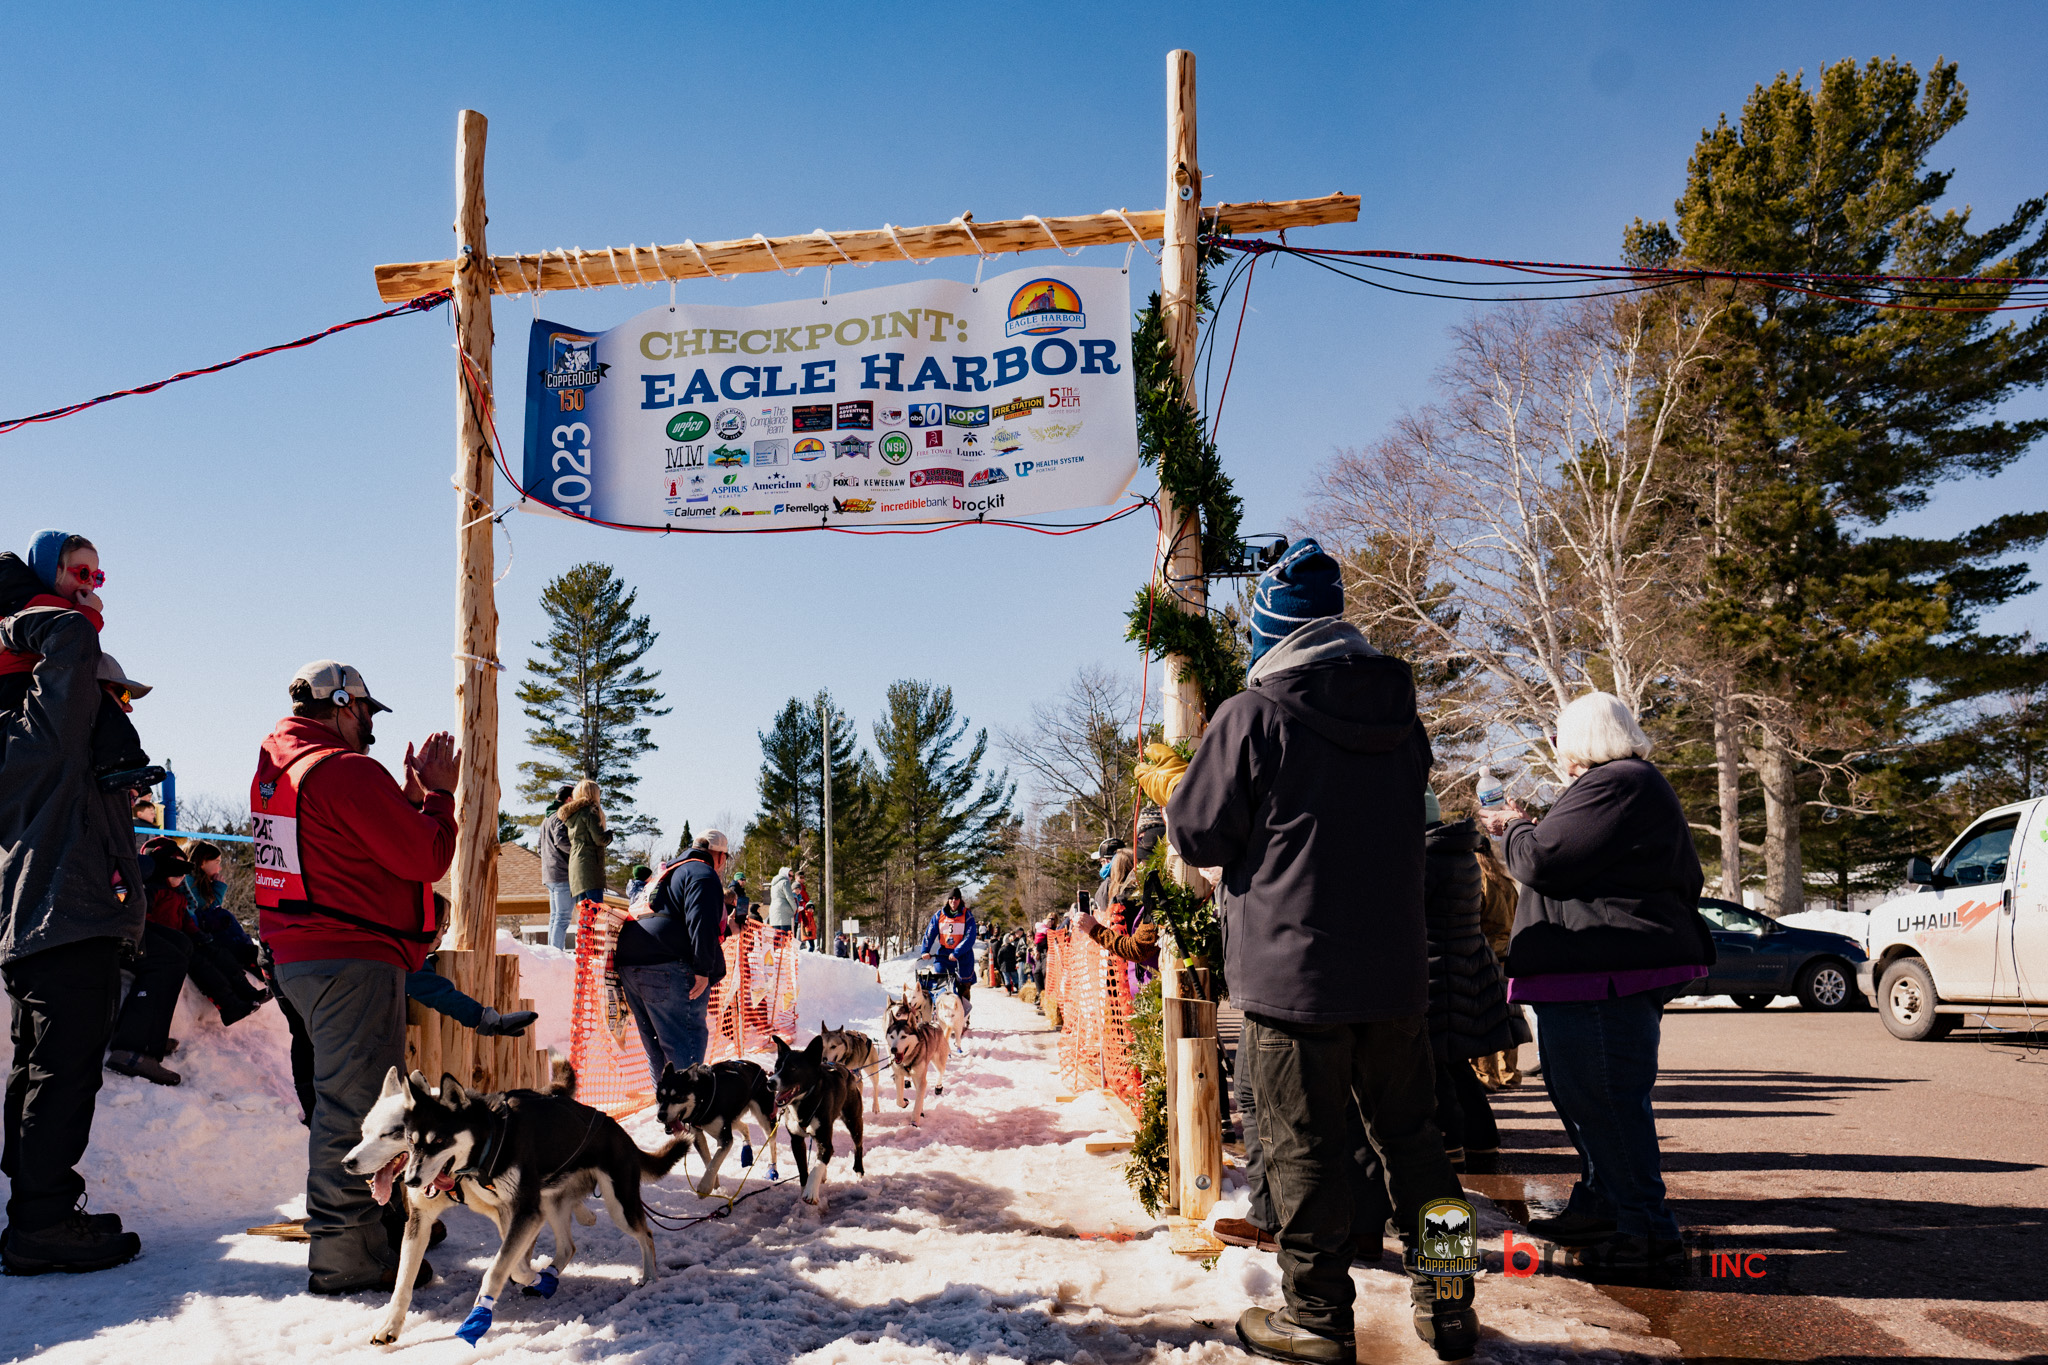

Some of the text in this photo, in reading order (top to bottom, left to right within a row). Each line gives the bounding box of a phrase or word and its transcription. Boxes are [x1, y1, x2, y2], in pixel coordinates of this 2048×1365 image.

[1009, 315, 1038, 330] EAGLE
[1041, 314, 1082, 322] HARBOR
[639, 307, 968, 361] CHECKPOINT:
[641, 338, 1121, 410] EAGLE HARBOR
[558, 388, 585, 412] 150
[1061, 398, 1080, 407] ELM
[773, 406, 786, 416] The
[994, 405, 1010, 417] FIRE
[1011, 399, 1042, 411] STATION
[919, 404, 940, 426] 10
[948, 408, 985, 421] KORC
[750, 415, 788, 427] Compliance
[767, 425, 784, 435] Team
[887, 442, 905, 452] NSH
[1036, 456, 1084, 468] HEALTH SYSTEM
[1014, 461, 1034, 477] UP
[752, 480, 801, 491] AmericInn
[864, 478, 906, 487] KEWEENAW
[712, 485, 748, 494] ASPIRUS
[881, 496, 948, 512] incrediblebank
[953, 494, 1005, 511] brockit
[674, 506, 716, 517] Calumet
[1898, 911, 1962, 933] U-HAUL
[948, 923, 954, 934] 3
